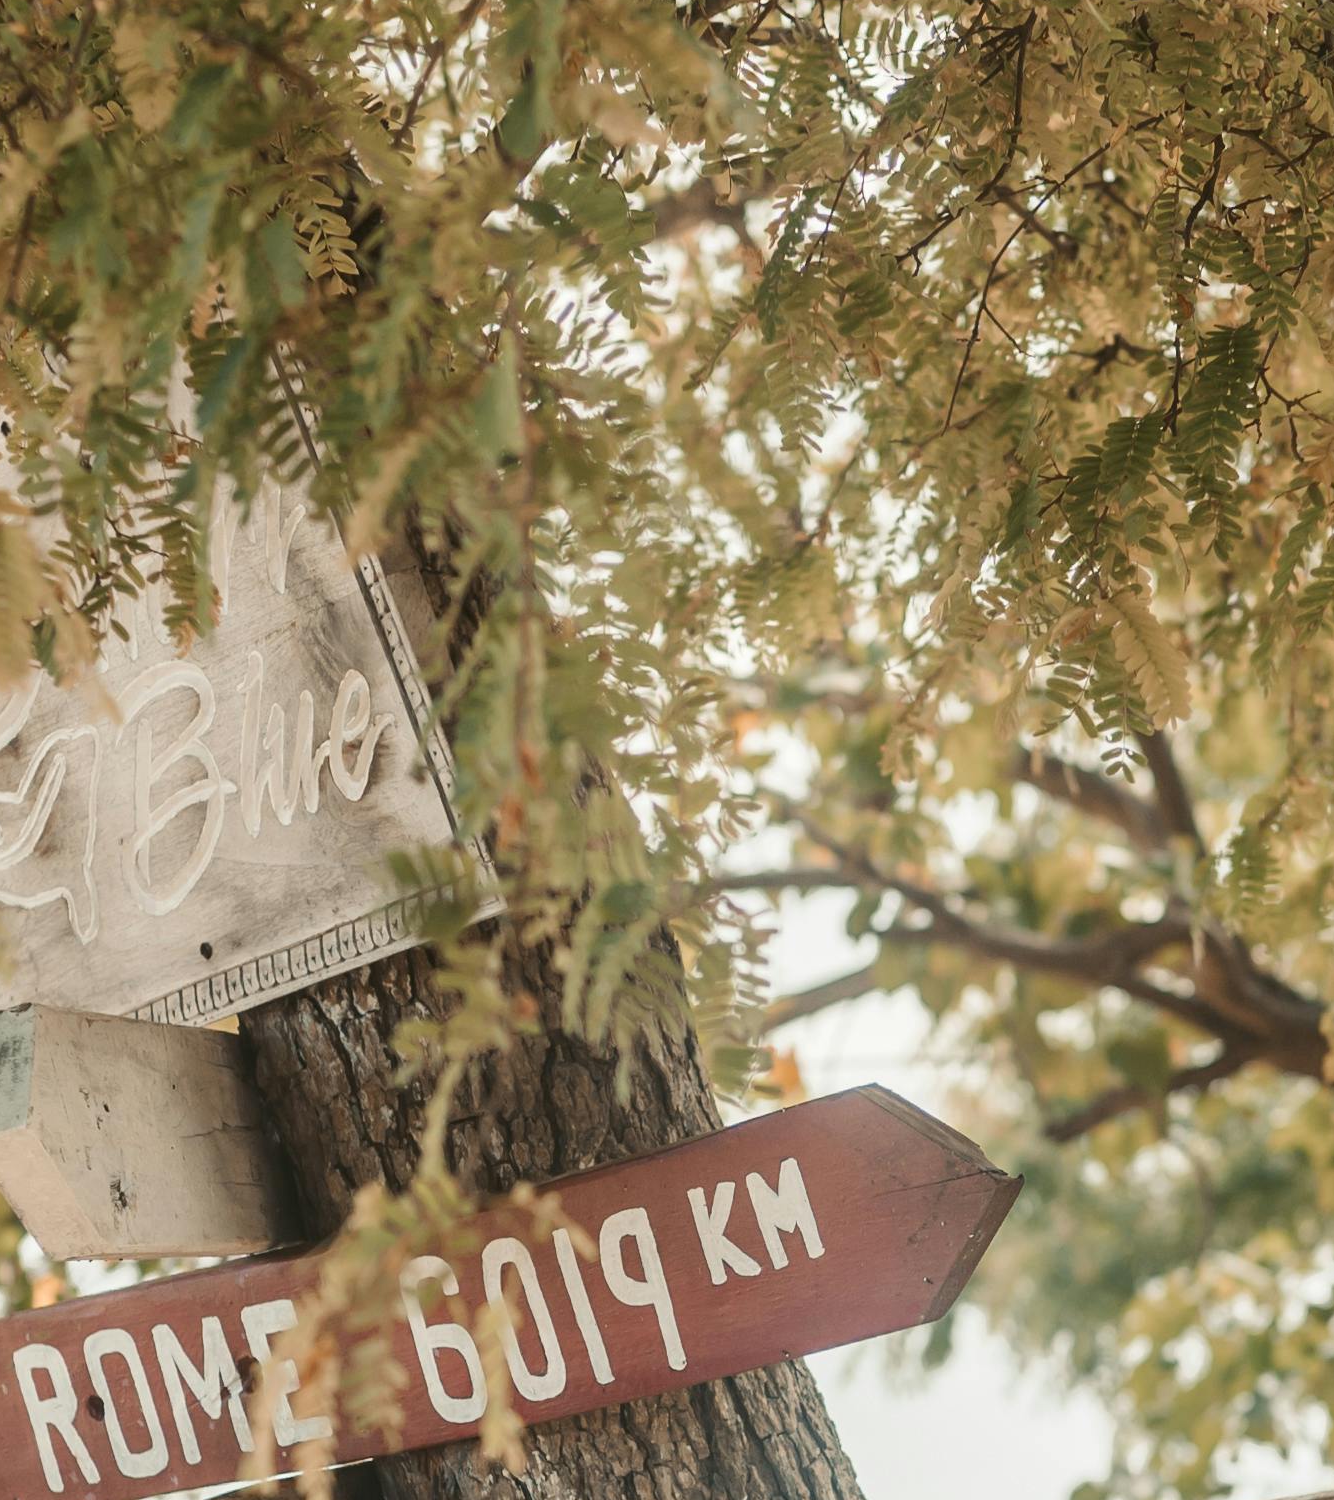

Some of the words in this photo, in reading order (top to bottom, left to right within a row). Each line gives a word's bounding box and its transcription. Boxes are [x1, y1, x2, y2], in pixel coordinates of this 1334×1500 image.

[12, 1298, 334, 1494] ROME
[399, 1206, 687, 1424] 6019
[686, 1157, 825, 1285] KM
